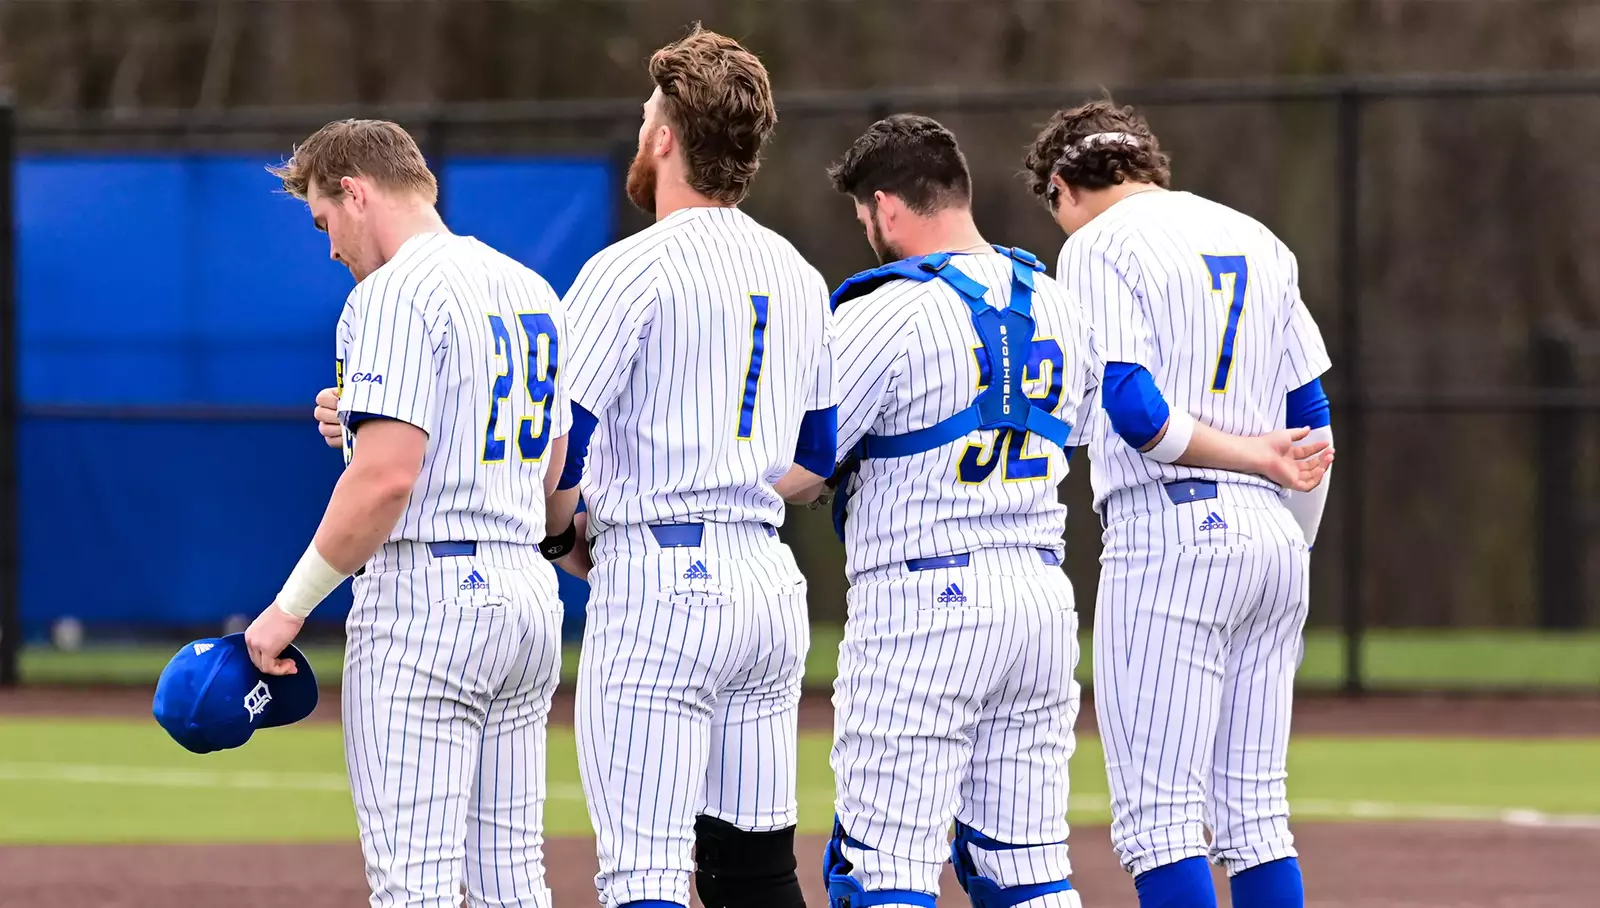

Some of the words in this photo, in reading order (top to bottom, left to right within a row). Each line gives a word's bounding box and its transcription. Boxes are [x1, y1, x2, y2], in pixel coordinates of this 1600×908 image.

[1199, 252, 1249, 393] 7
[734, 292, 771, 441] 1
[1000, 325, 1011, 415] EVOSHIELD
[351, 372, 383, 385] CAA
[480, 311, 561, 464] 29
[1198, 522, 1228, 531] adidas
[683, 572, 712, 580] adidas
[459, 581, 490, 591] adidas
[936, 595, 967, 603] adidas
